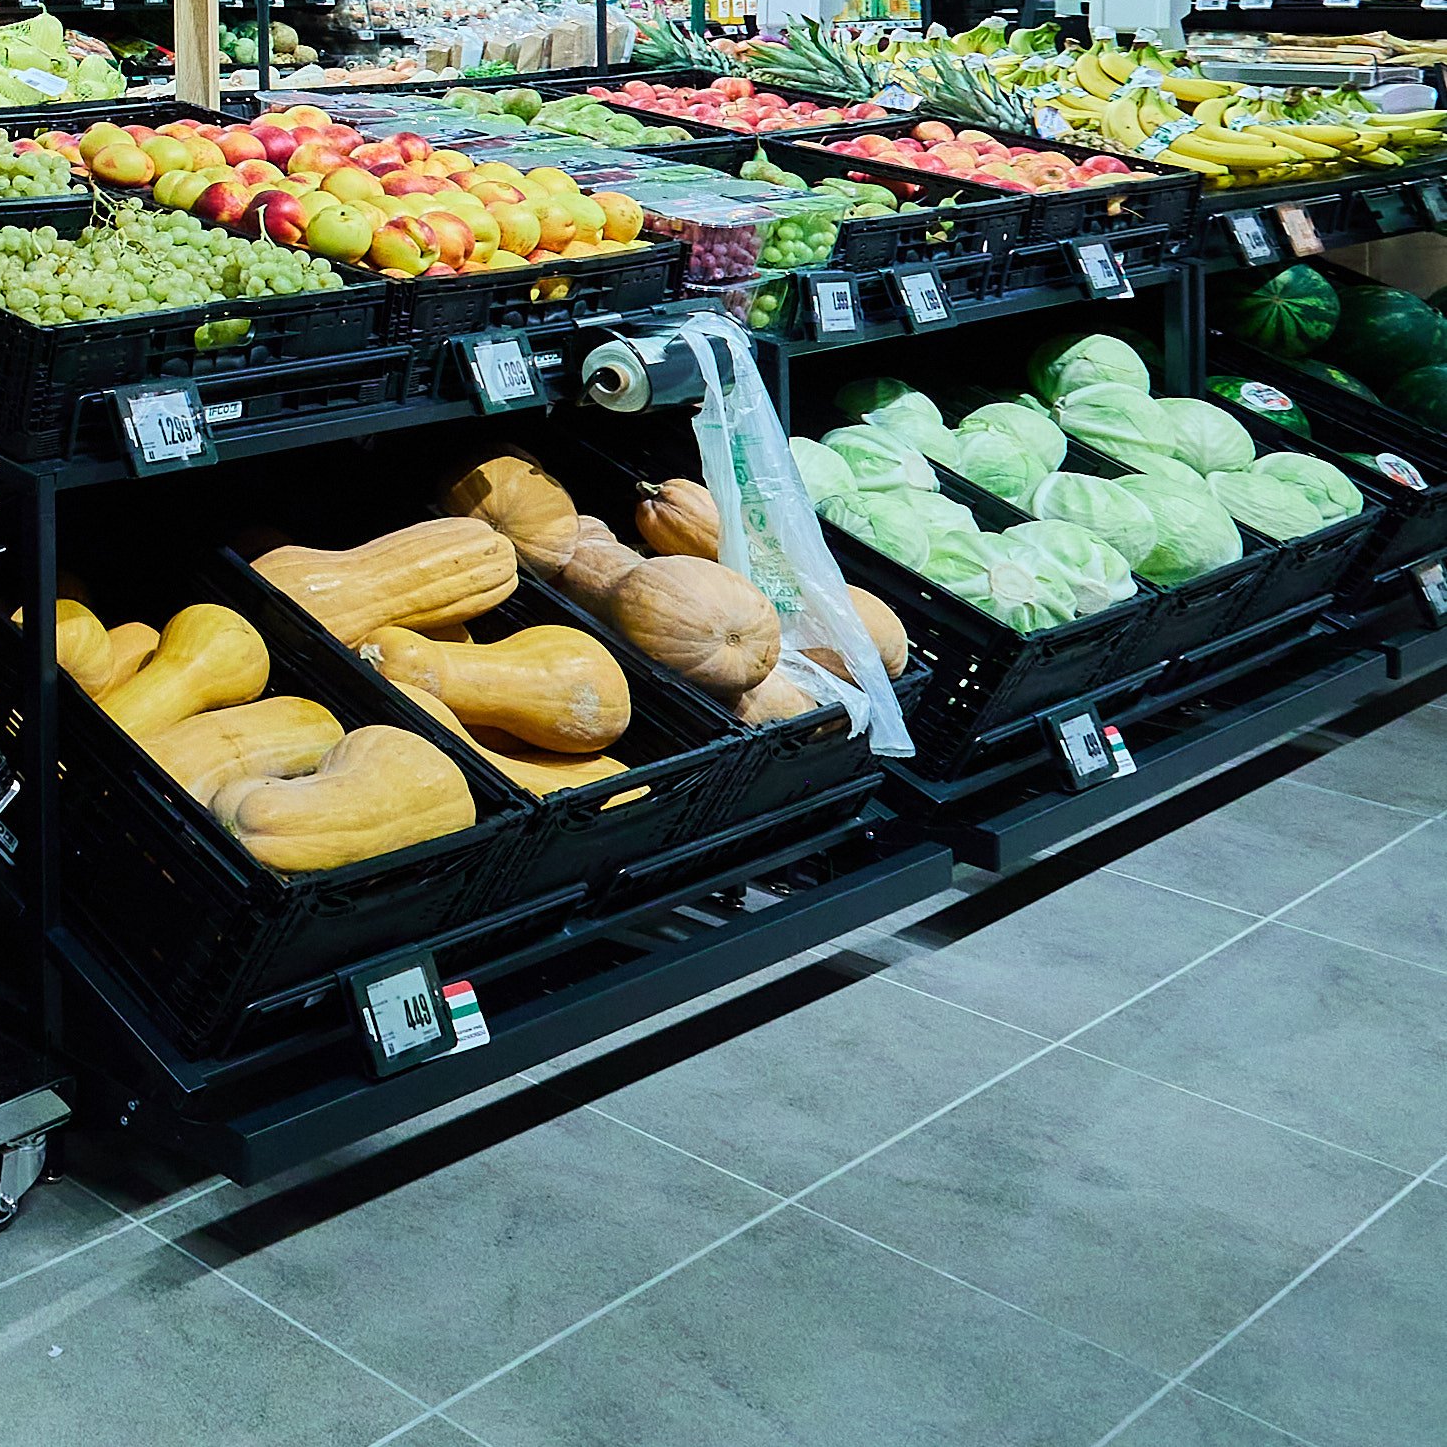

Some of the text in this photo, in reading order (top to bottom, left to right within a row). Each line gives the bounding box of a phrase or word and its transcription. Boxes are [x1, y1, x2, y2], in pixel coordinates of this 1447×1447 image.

[498, 360, 526, 388] 1.399
[209, 405, 229, 416] IFCO
[158, 415, 192, 446] 1.299
[403, 994, 432, 1030] 449
